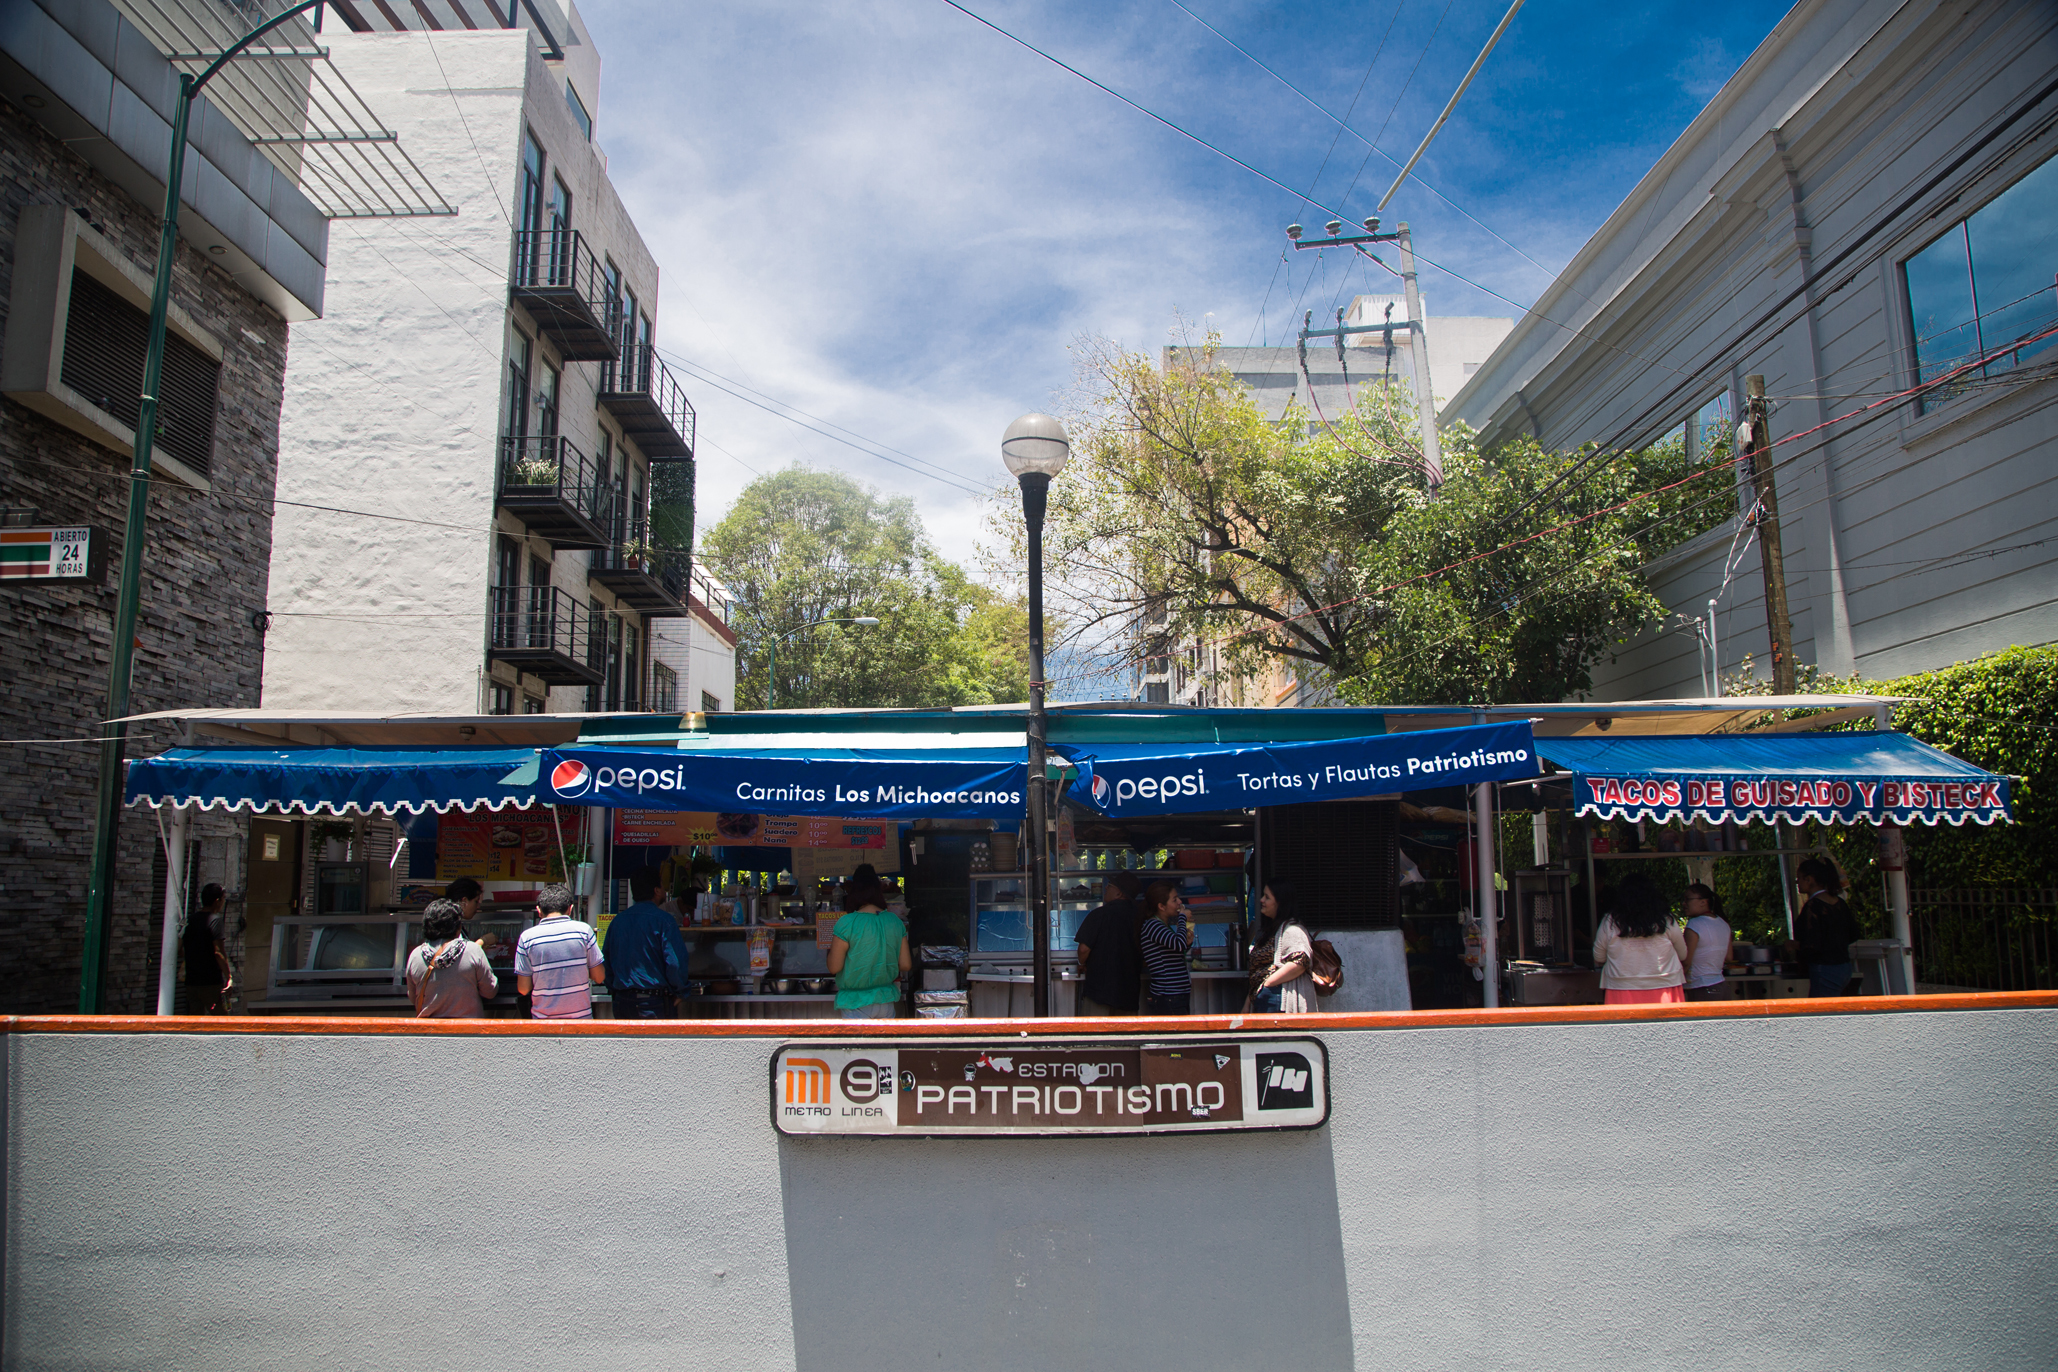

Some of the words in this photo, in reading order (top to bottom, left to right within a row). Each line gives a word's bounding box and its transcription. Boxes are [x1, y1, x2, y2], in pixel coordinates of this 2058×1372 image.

[54, 531, 87, 542] ABIERTO
[62, 544, 79, 561] 24
[56, 563, 83, 574] HORAS
[594, 764, 684, 795] pepsi
[1237, 772, 1303, 792] Tortas
[1309, 773, 1319, 790] y
[1325, 763, 1400, 783] Flautas
[1407, 748, 1528, 776] Patriotismo
[736, 782, 825, 802] Carnitas
[835, 784, 870, 803] Los
[876, 785, 1020, 804] Michoacanos
[1117, 768, 1206, 806] pepsi
[1587, 778, 1681, 807] TACOS
[1687, 780, 1725, 807] DE
[1731, 780, 1852, 808] GUISADO
[1856, 782, 1877, 808] Y
[1883, 781, 2003, 809] BISTECK
[842, 826, 882, 835] REFRESCOS
[846, 1066, 877, 1097] 9
[1018, 1063, 1125, 1078] ESTACON
[916, 1081, 1226, 1115] PATRIOTISMO
[785, 1107, 831, 1116] METRO
[841, 1107, 883, 1117] LINEA
